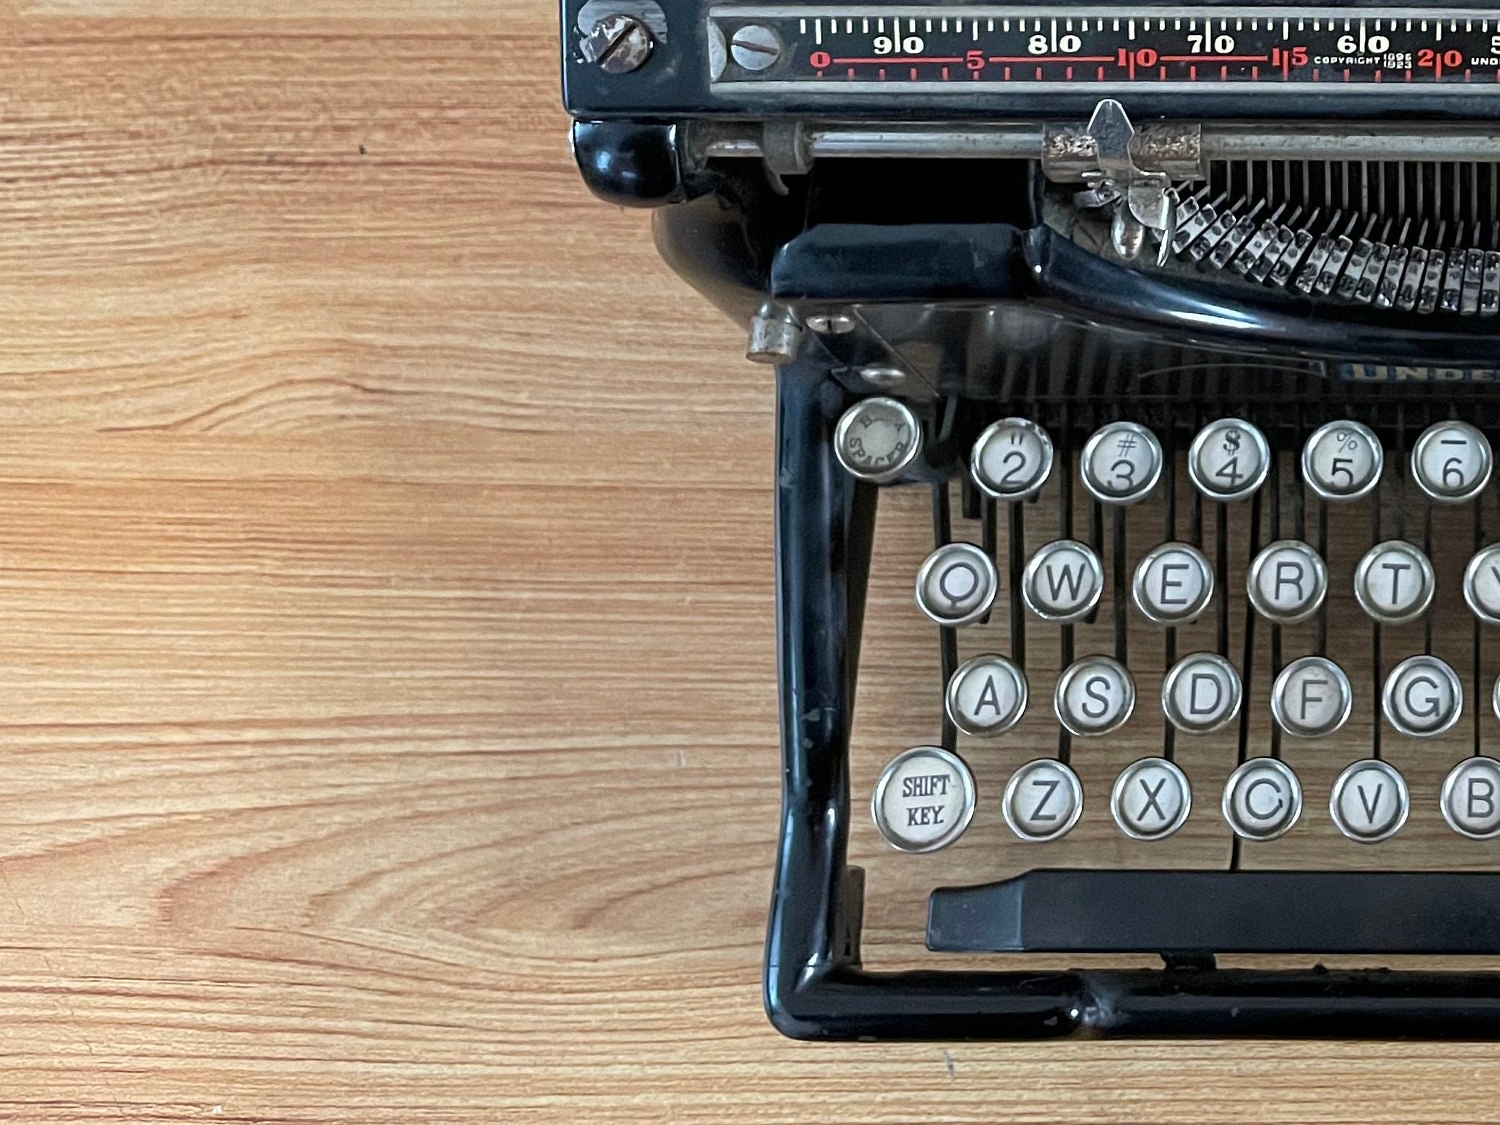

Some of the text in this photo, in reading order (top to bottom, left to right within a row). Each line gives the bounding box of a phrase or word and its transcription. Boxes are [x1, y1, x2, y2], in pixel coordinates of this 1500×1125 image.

[809, 51, 831, 69] 0
[965, 50, 985, 70] 5
[1117, 48, 1157, 67] 10
[1272, 47, 1308, 67] 15
[1417, 49, 1463, 68] 20
[873, 36, 924, 54] 90
[1028, 35, 1081, 54] 80
[1187, 35, 1235, 54] 70
[1337, 35, 1390, 54] 60
[1313, 56, 1381, 64] COPYRIGHT
[1222, 429, 1241, 456] $
[1336, 431, 1357, 452] %
[1000, 451, 1026, 485] 2
[1106, 460, 1135, 488] 3
[1215, 456, 1244, 485] 4
[1331, 458, 1354, 485] 5
[1443, 457, 1465, 487] 6
[1045, 562, 1087, 602] W
[1159, 563, 1190, 605] E
[1274, 561, 1305, 601] R
[1382, 563, 1411, 605] T
[973, 674, 1002, 717] A
[1081, 676, 1111, 719] S
[1189, 673, 1223, 716] D
[1300, 678, 1330, 720] F
[1403, 676, 1441, 718] G
[902, 774, 951, 798] SHIFT
[1029, 779, 1060, 822] Z
[1136, 777, 1168, 822] X
[1245, 777, 1284, 820] C
[1356, 783, 1384, 825] V
[1467, 777, 1495, 819] B
